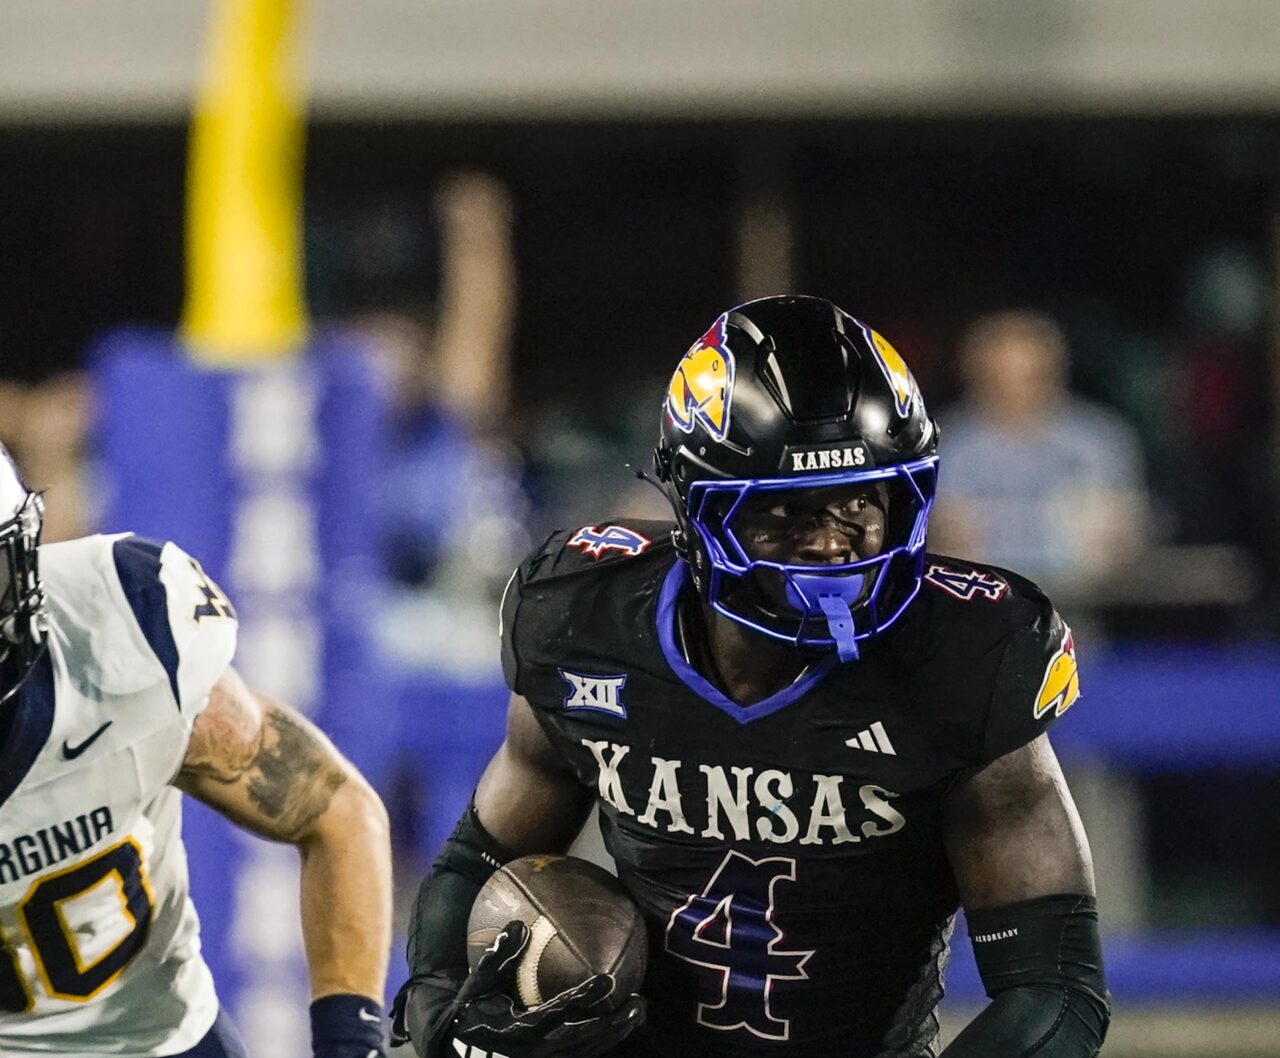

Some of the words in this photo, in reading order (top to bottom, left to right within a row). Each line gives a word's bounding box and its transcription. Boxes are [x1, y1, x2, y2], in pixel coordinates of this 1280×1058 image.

[791, 447, 866, 471] KANSAS
[565, 525, 652, 561] 4
[923, 564, 1007, 602] 4
[581, 738, 906, 845] KANSAS
[665, 849, 816, 1041] 4
[974, 927, 1018, 943] AEROREADY
